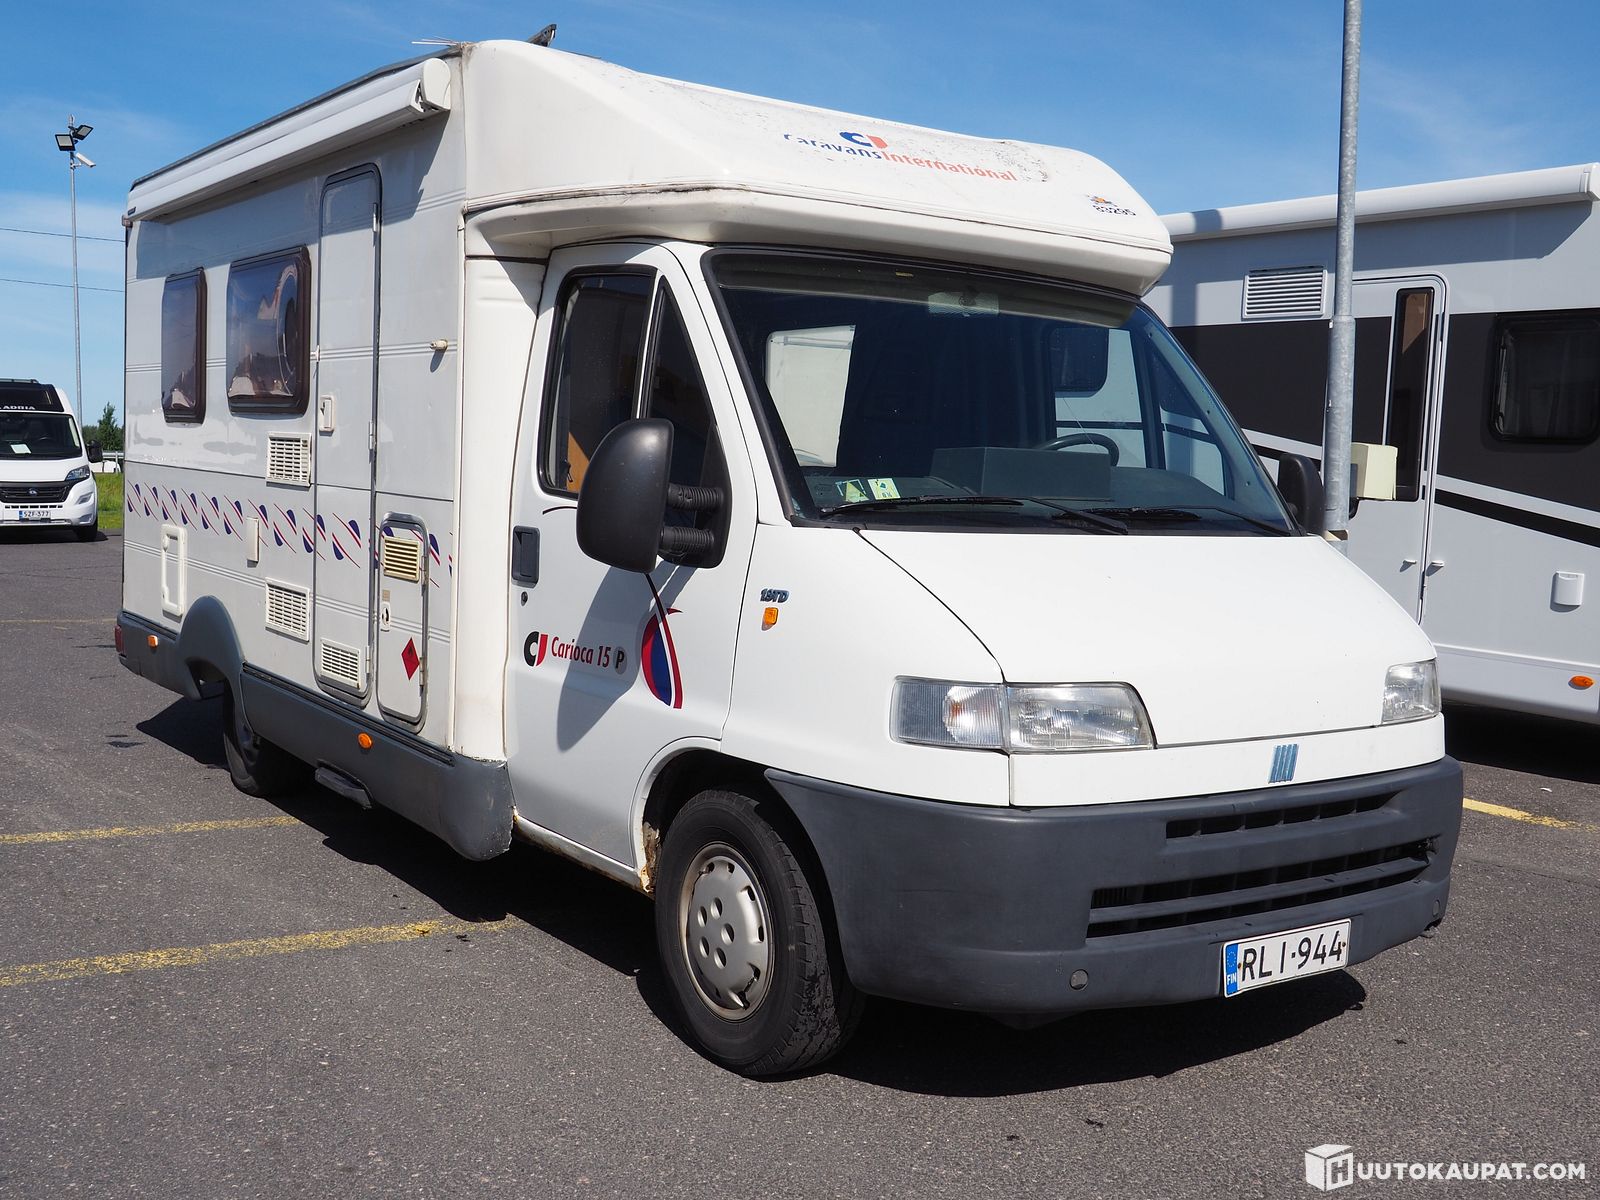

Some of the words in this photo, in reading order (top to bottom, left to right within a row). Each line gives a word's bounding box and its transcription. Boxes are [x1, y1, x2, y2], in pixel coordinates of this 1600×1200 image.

[551, 636, 594, 665] Carioca
[597, 645, 612, 667] 15
[615, 650, 625, 669] P
[1226, 972, 1237, 985] FIN
